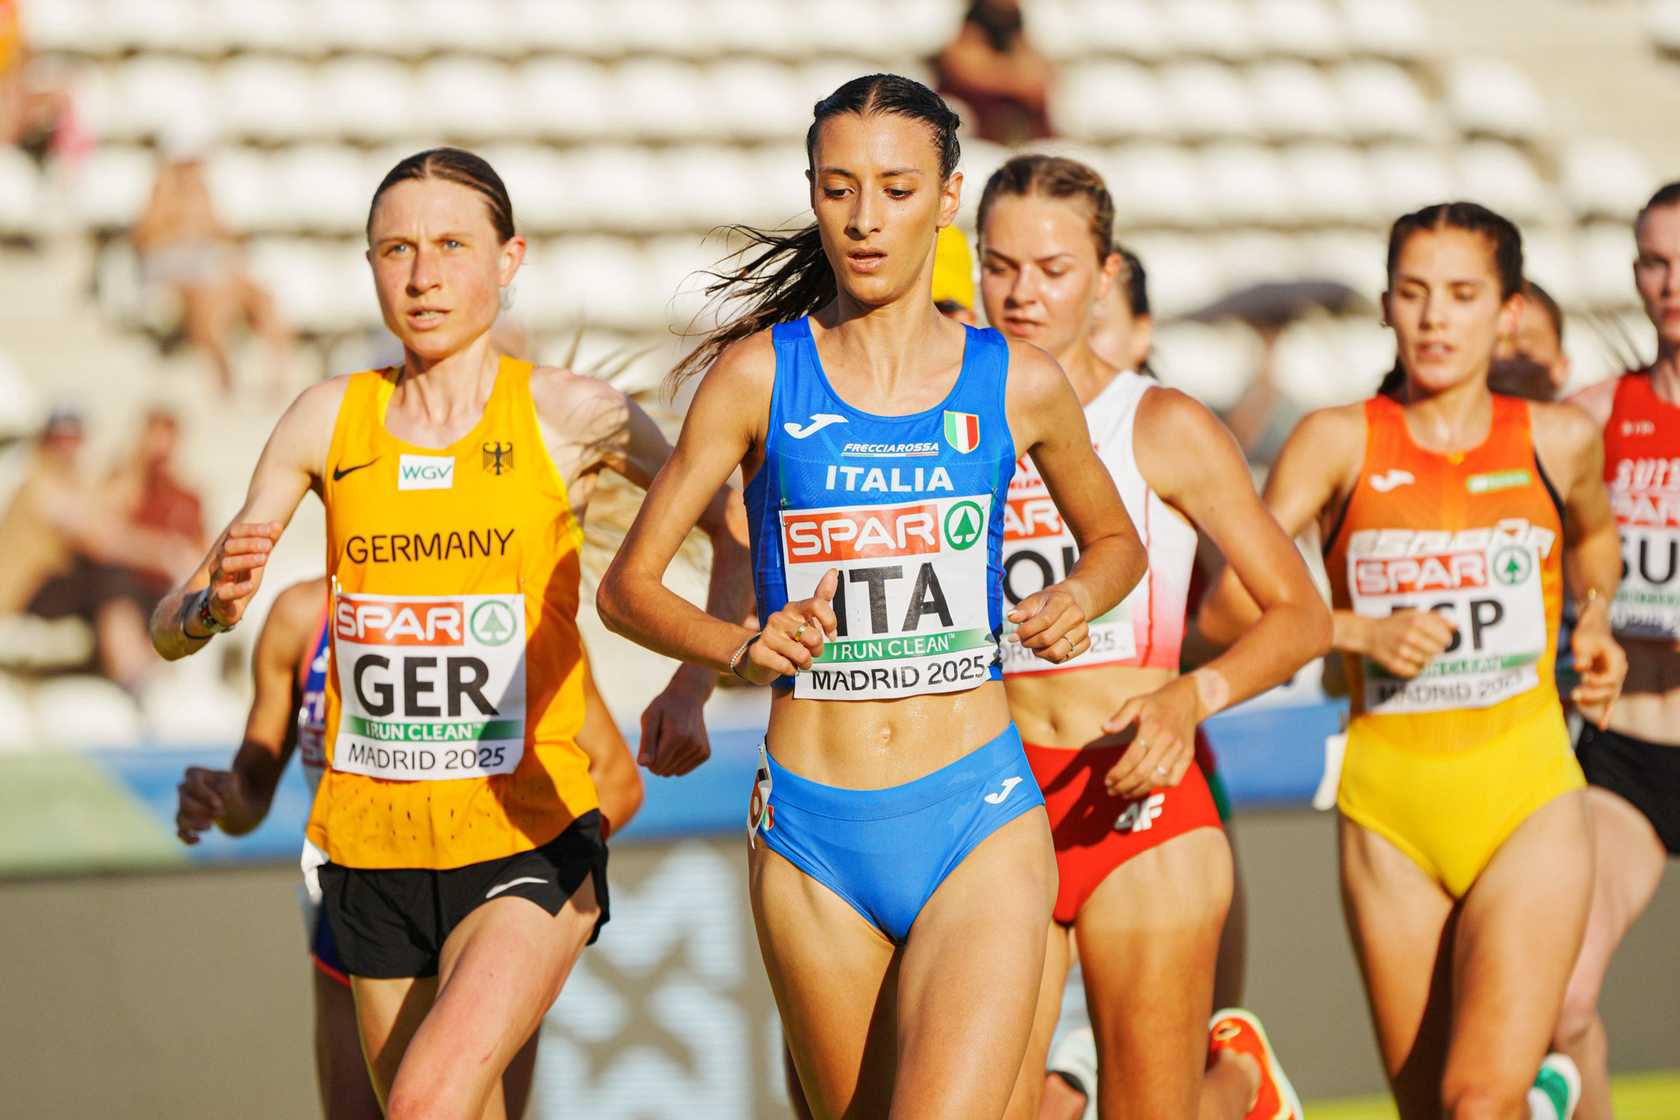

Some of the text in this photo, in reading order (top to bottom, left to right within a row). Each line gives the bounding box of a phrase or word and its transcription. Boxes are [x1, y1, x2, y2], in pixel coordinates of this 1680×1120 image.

[843, 442, 940, 453] FRECCIAROSSA
[401, 464, 453, 481] WGV
[825, 464, 955, 492] ITALIA
[788, 512, 936, 556] SPAR
[1004, 501, 1062, 536] AR
[346, 528, 515, 564] GERMANY
[1359, 552, 1486, 593] SPAR
[830, 562, 954, 637] ITA
[337, 603, 462, 641] SPAR
[832, 642, 837, 660] I
[841, 641, 884, 659] RUN
[353, 653, 500, 718] GER
[811, 656, 986, 691] MADRID 2025
[372, 722, 404, 738] RUN
[348, 742, 436, 770] MADRID
[445, 747, 507, 769] 2025
